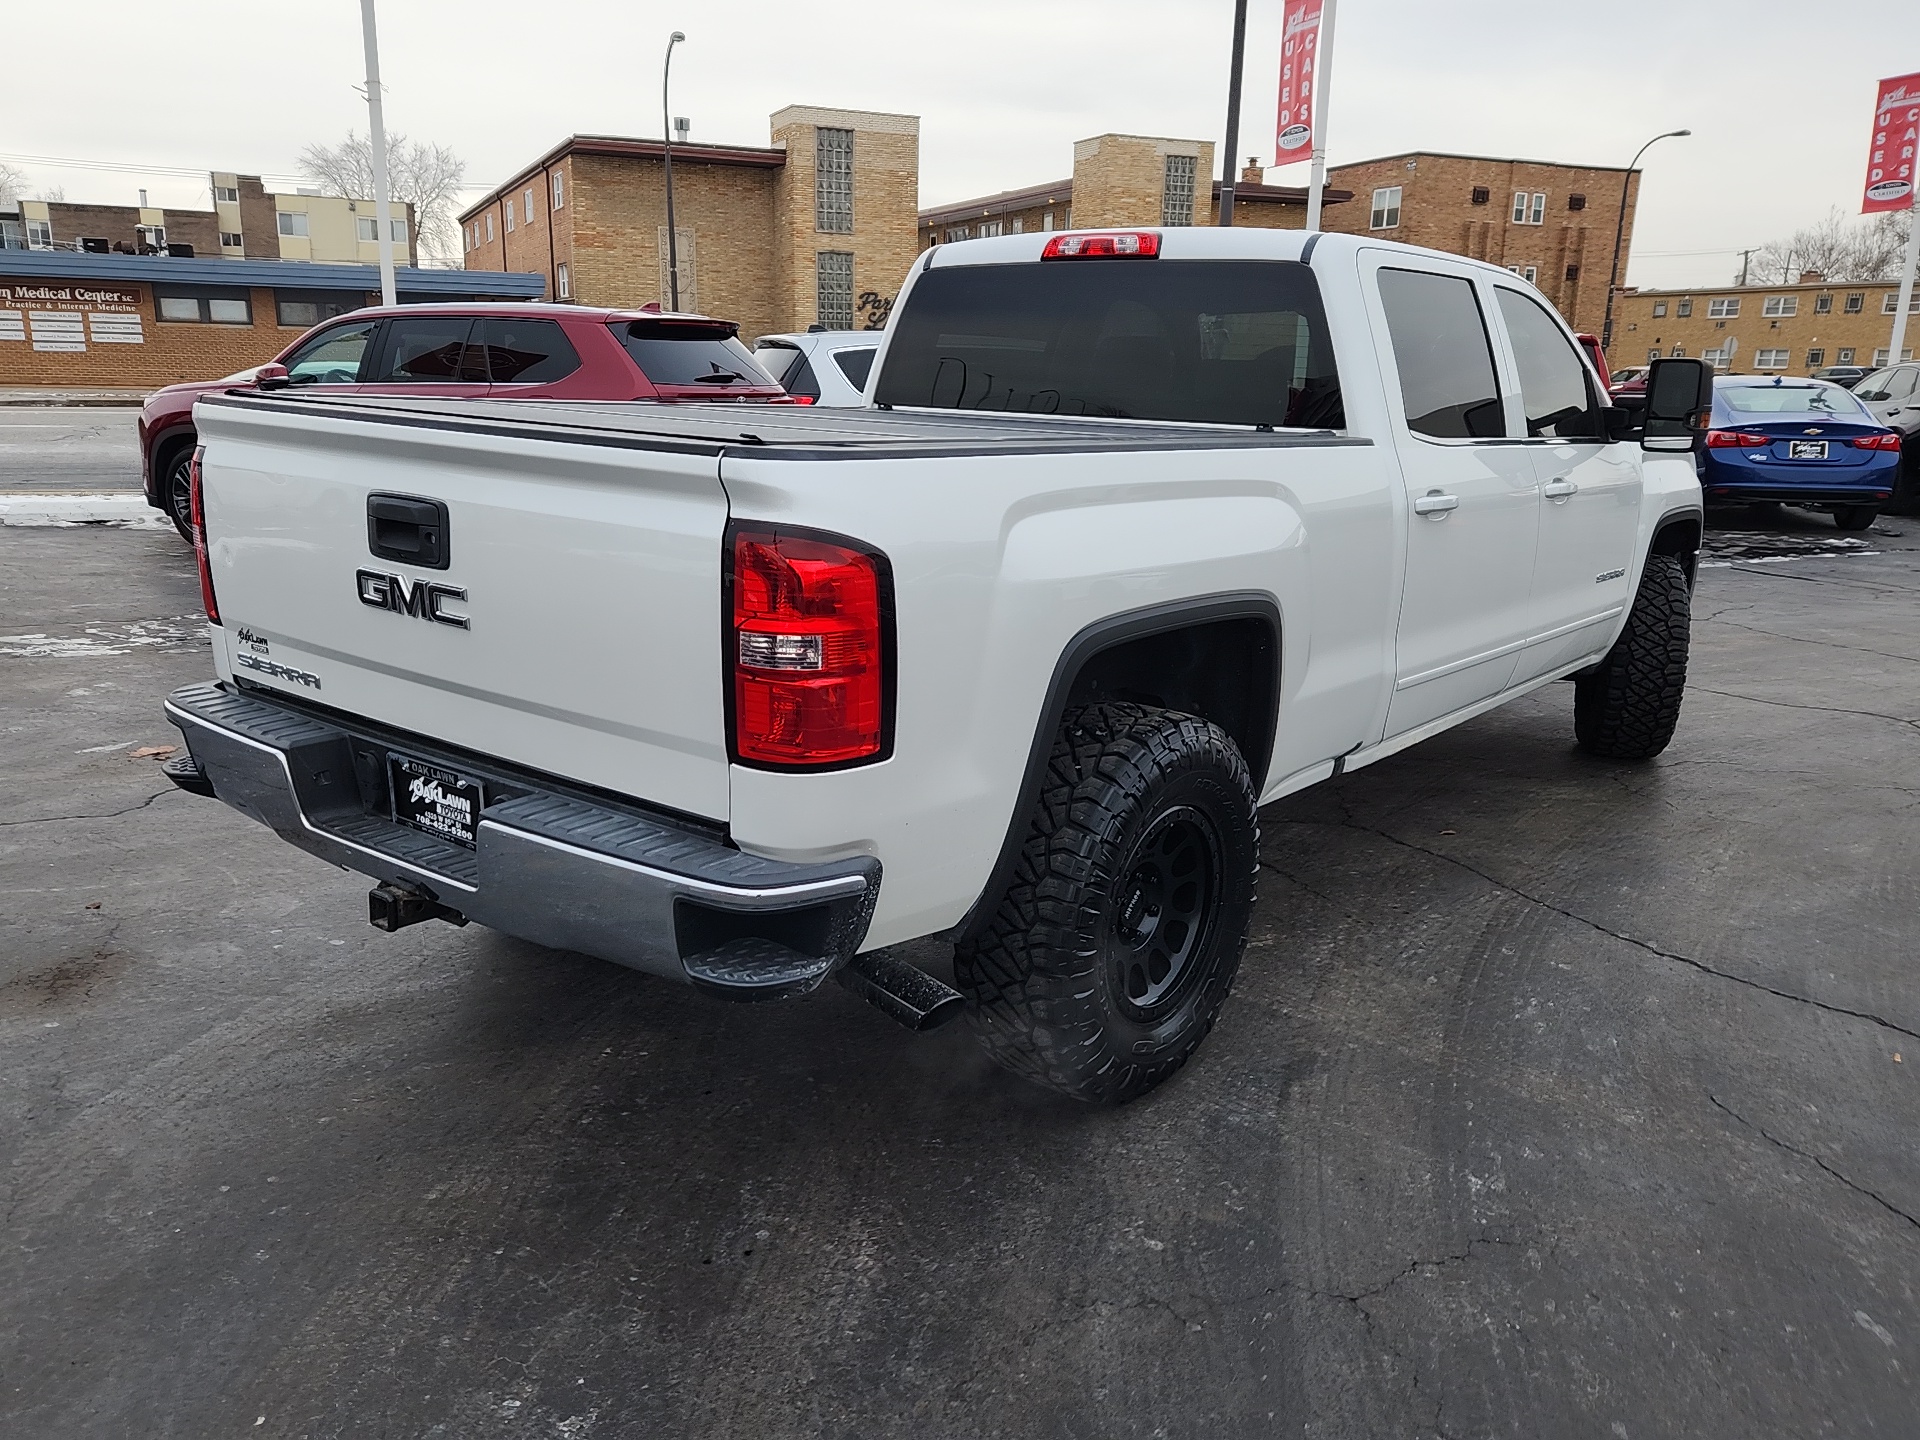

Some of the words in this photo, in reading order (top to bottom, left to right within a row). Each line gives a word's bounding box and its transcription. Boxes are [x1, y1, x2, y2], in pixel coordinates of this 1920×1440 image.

[1281, 40, 1294, 126] USED
[1301, 33, 1315, 121] CARS
[1871, 113, 1891, 182] USED
[1899, 108, 1920, 178] CARS
[6, 300, 41, 309] Practice
[45, 301, 53, 309] &
[58, 302, 92, 311] Internal
[97, 303, 137, 312] Medicine
[15, 286, 71, 300] Medical
[75, 288, 121, 303] Center
[355, 565, 471, 632] GMC
[237, 651, 321, 690] SIERRA
[411, 763, 430, 777] OAK
[430, 768, 455, 785] LAWN
[415, 814, 473, 840] 708-423-5200
[438, 803, 471, 825] TOYOTA
